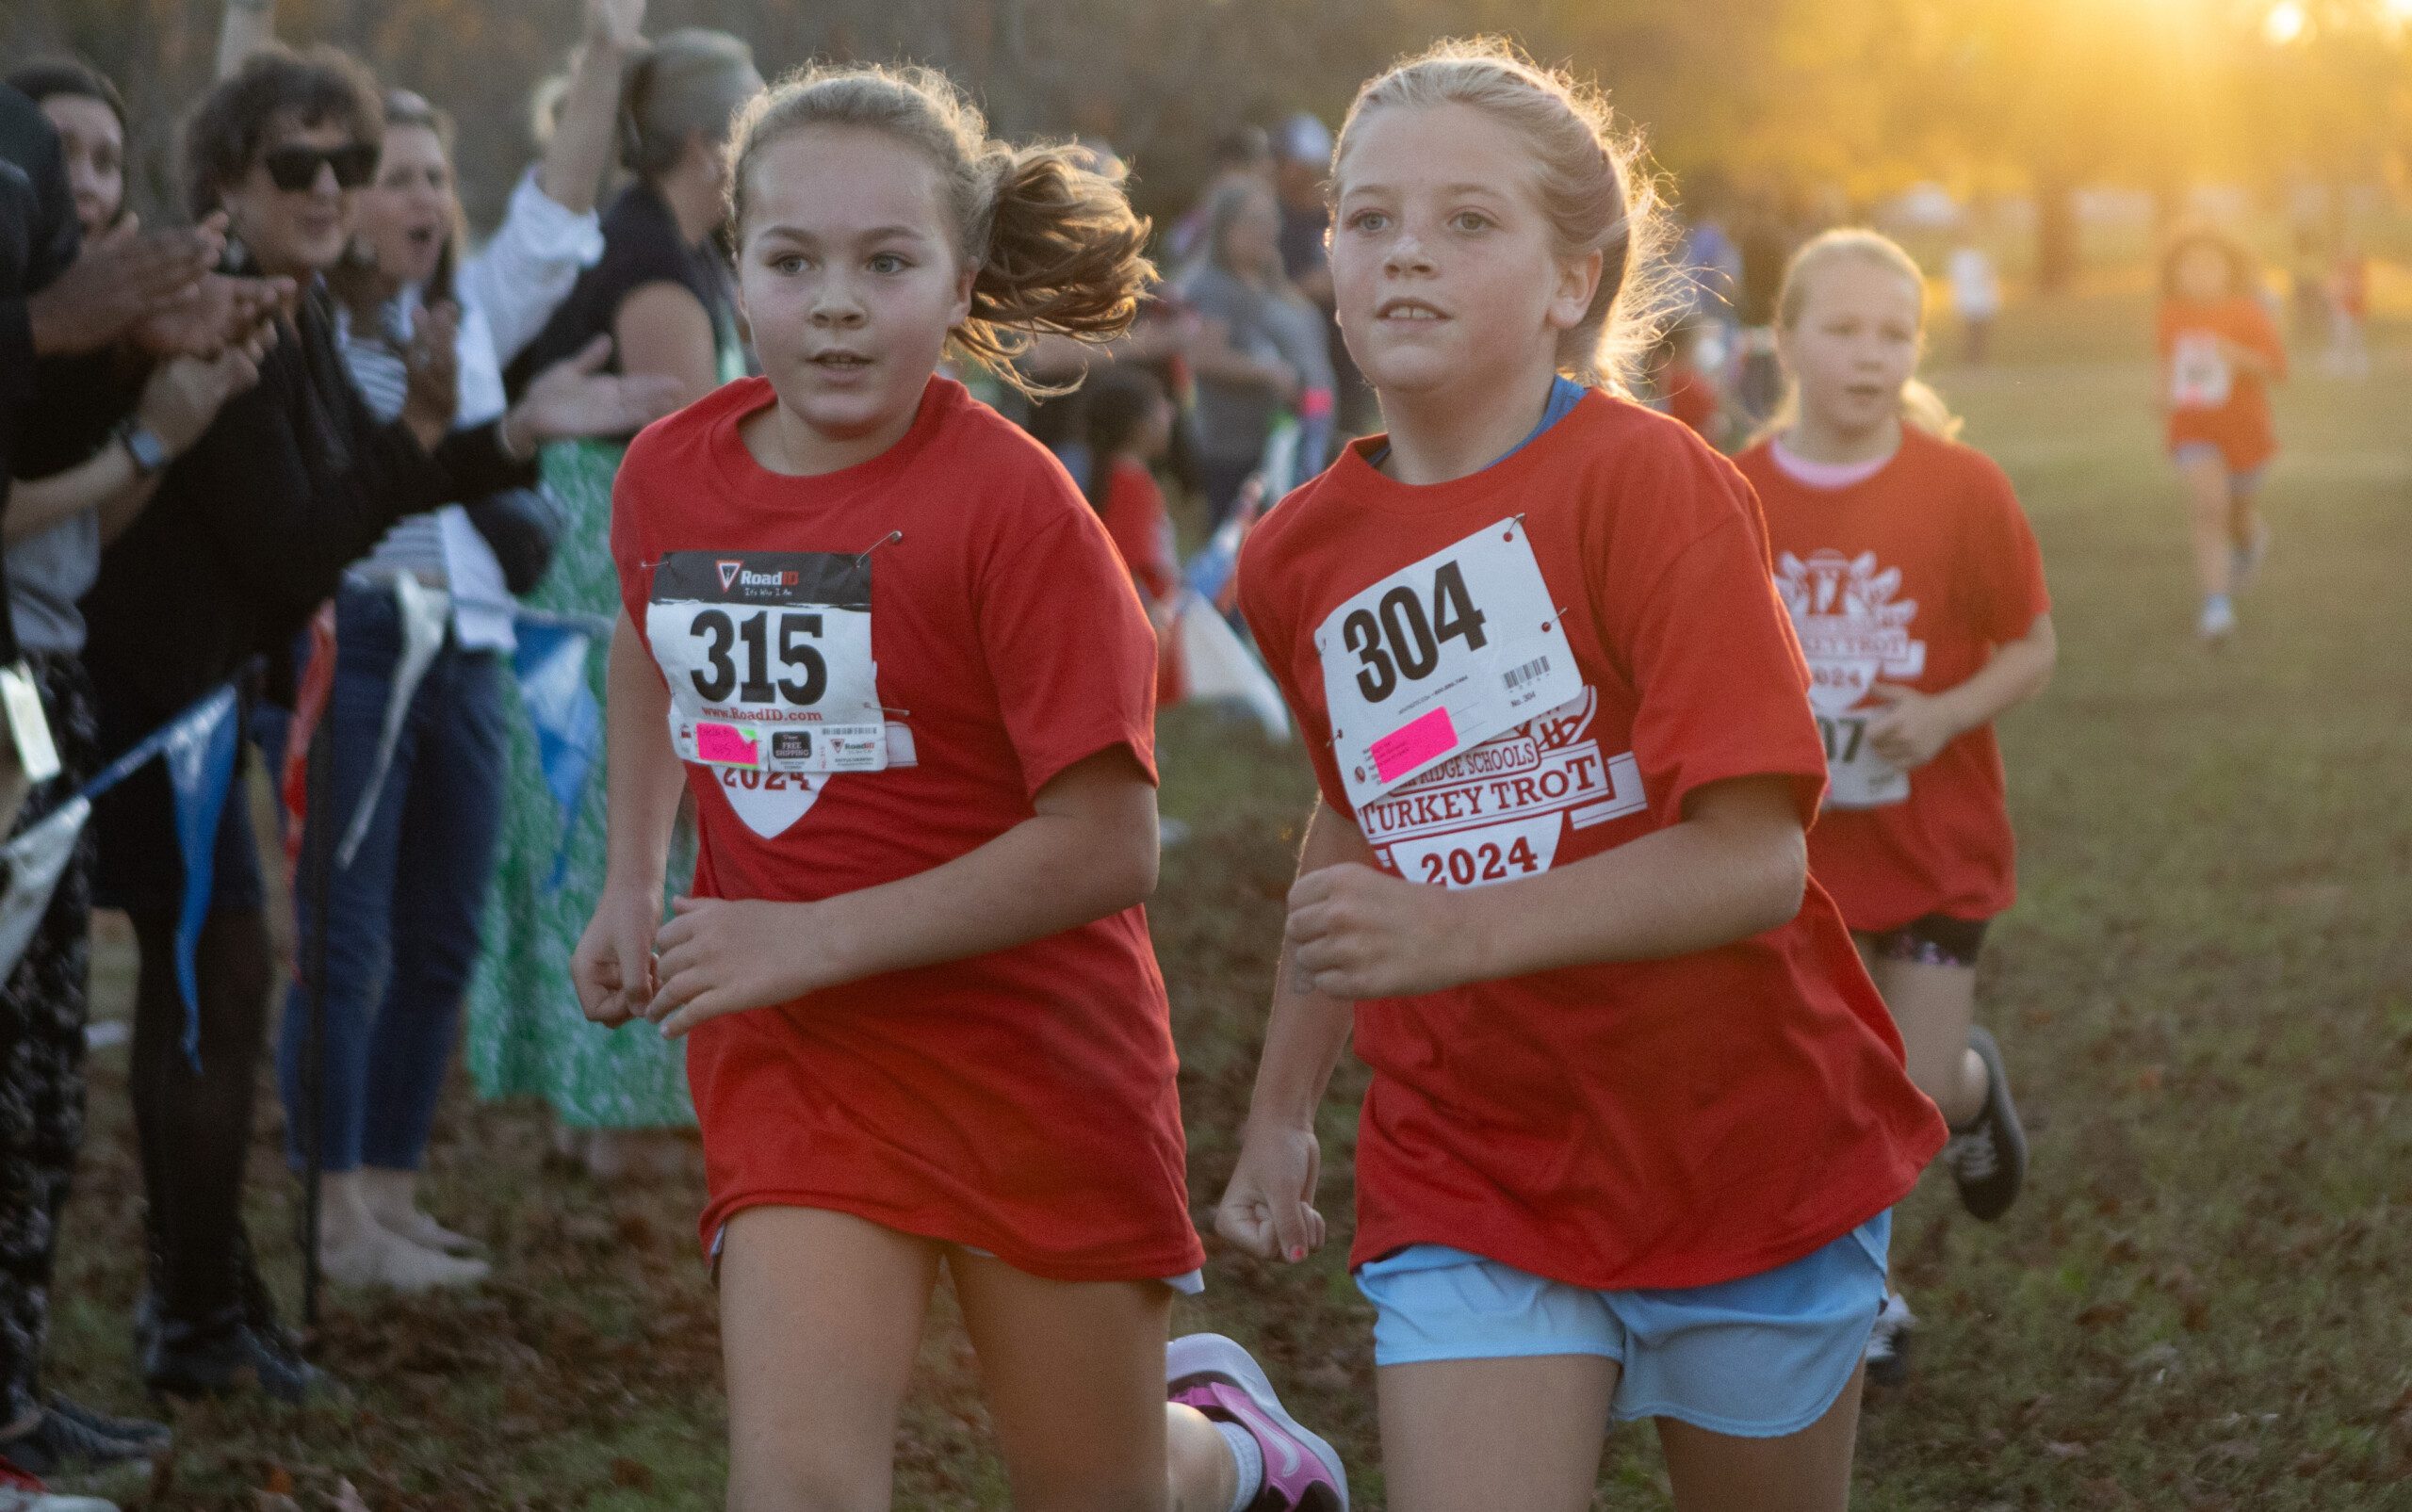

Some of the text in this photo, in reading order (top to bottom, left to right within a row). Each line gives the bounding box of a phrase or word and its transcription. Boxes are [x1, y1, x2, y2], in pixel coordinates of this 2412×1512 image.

[741, 570, 799, 586] RoadID
[1343, 560, 1488, 703] 304
[690, 609, 827, 706] 315
[702, 707, 823, 722] www.RoadID.com
[1465, 742, 1536, 774] SCHOOLS
[1359, 755, 1596, 835] TURKEY TROT
[1421, 836, 1538, 885] 2024
